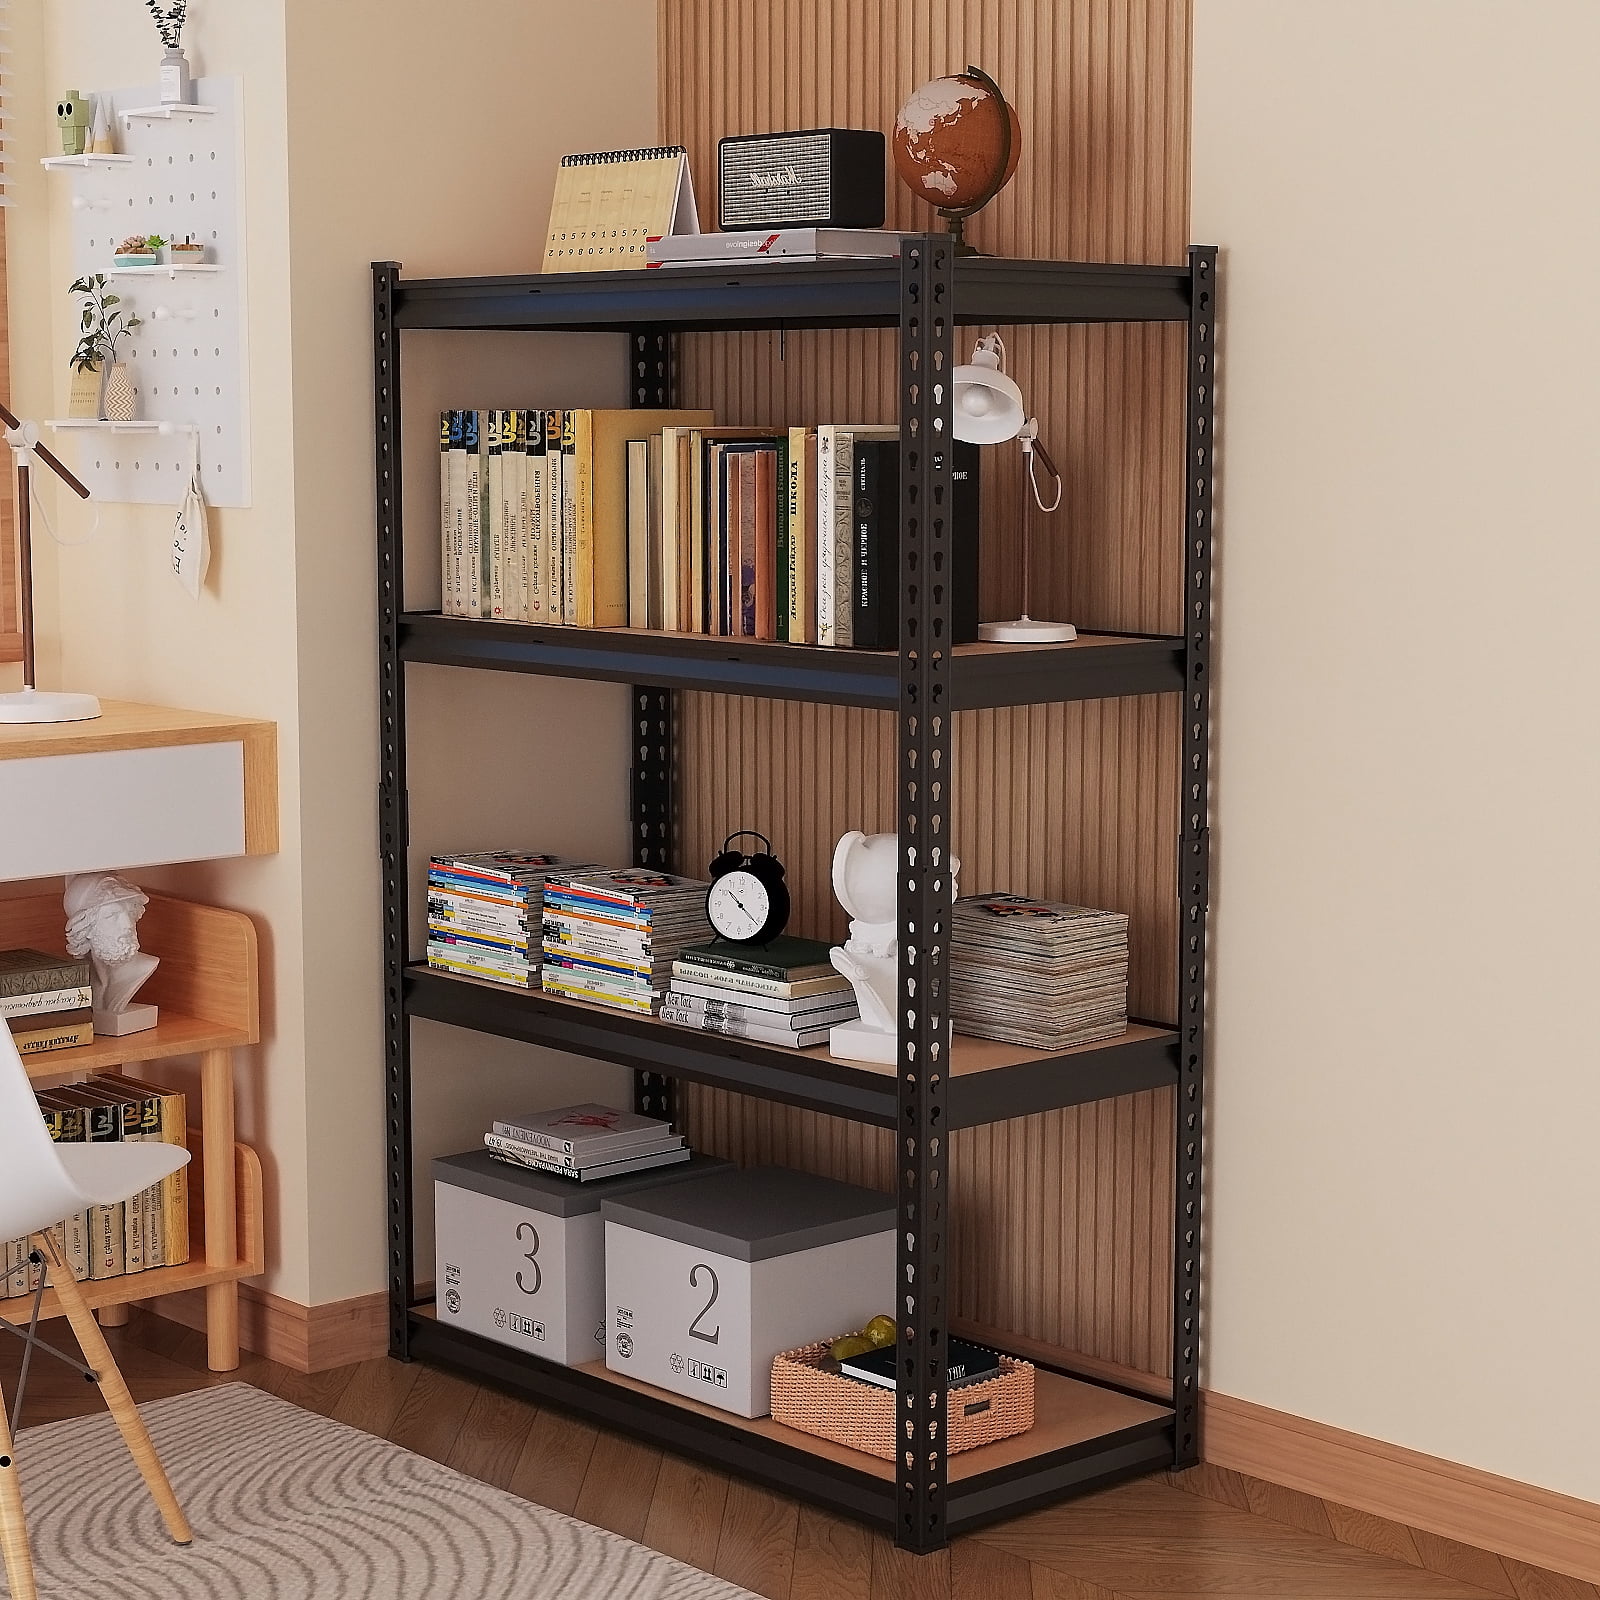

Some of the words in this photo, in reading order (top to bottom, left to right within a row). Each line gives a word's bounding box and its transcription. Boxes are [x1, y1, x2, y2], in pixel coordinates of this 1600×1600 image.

[790, 461, 798, 516] ШКОЛА
[860, 523, 868, 557] ЧЕРНОЕ
[563, 1167, 579, 1178] SARA
[515, 1222, 543, 1295] 3
[688, 1263, 721, 1345] 2
